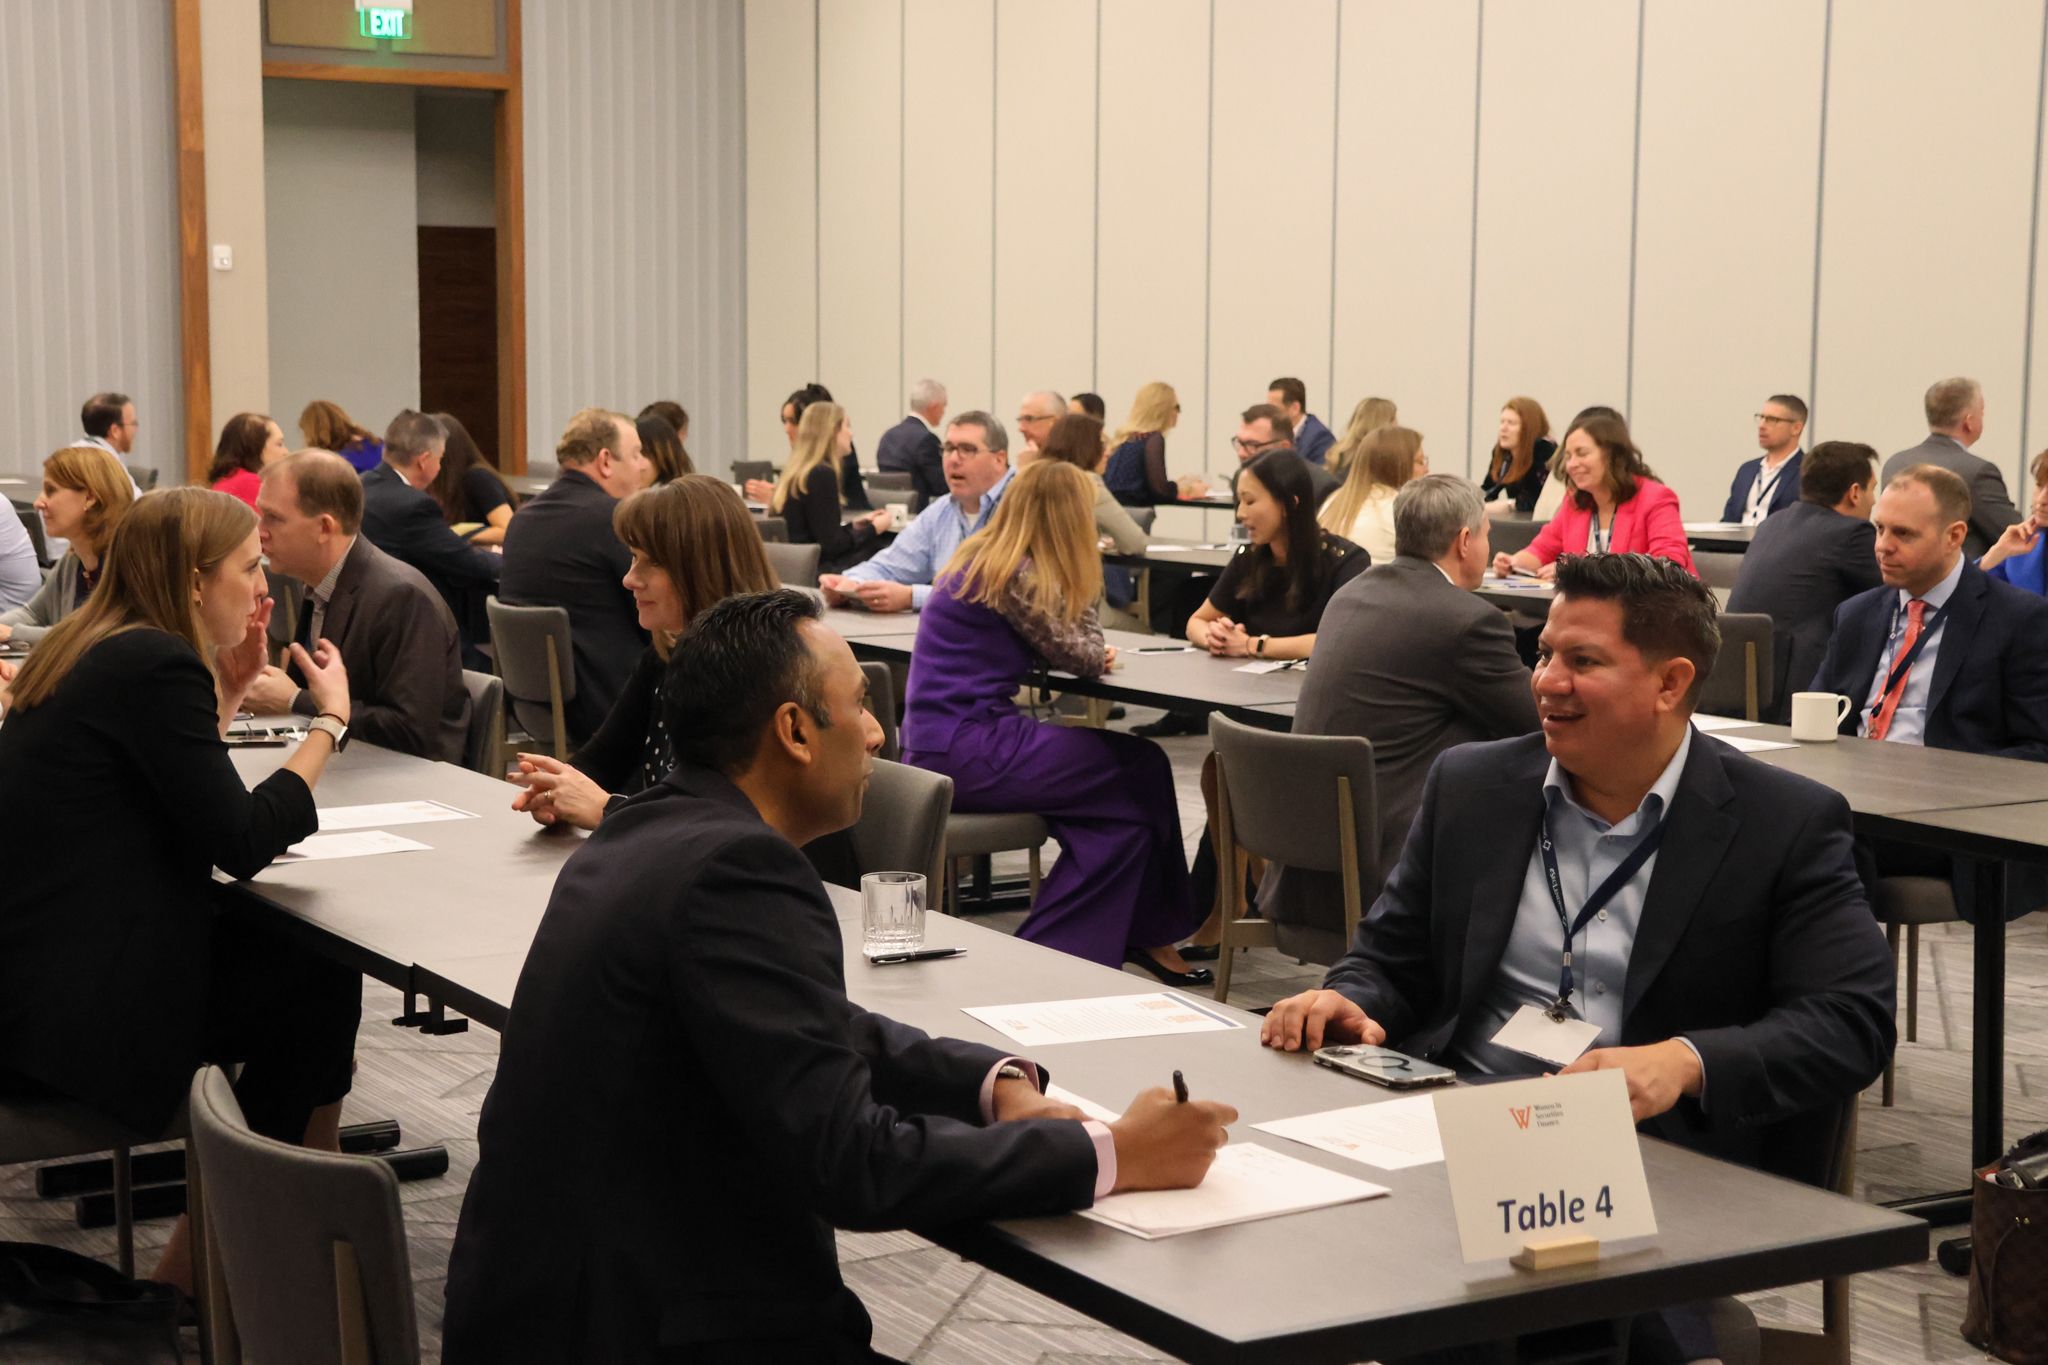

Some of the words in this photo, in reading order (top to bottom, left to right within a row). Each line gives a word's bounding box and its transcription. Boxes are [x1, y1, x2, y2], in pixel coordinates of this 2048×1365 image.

[370, 9, 404, 36] EXIT
[1497, 1189, 1585, 1233] Table
[1595, 1185, 1613, 1218] 4
